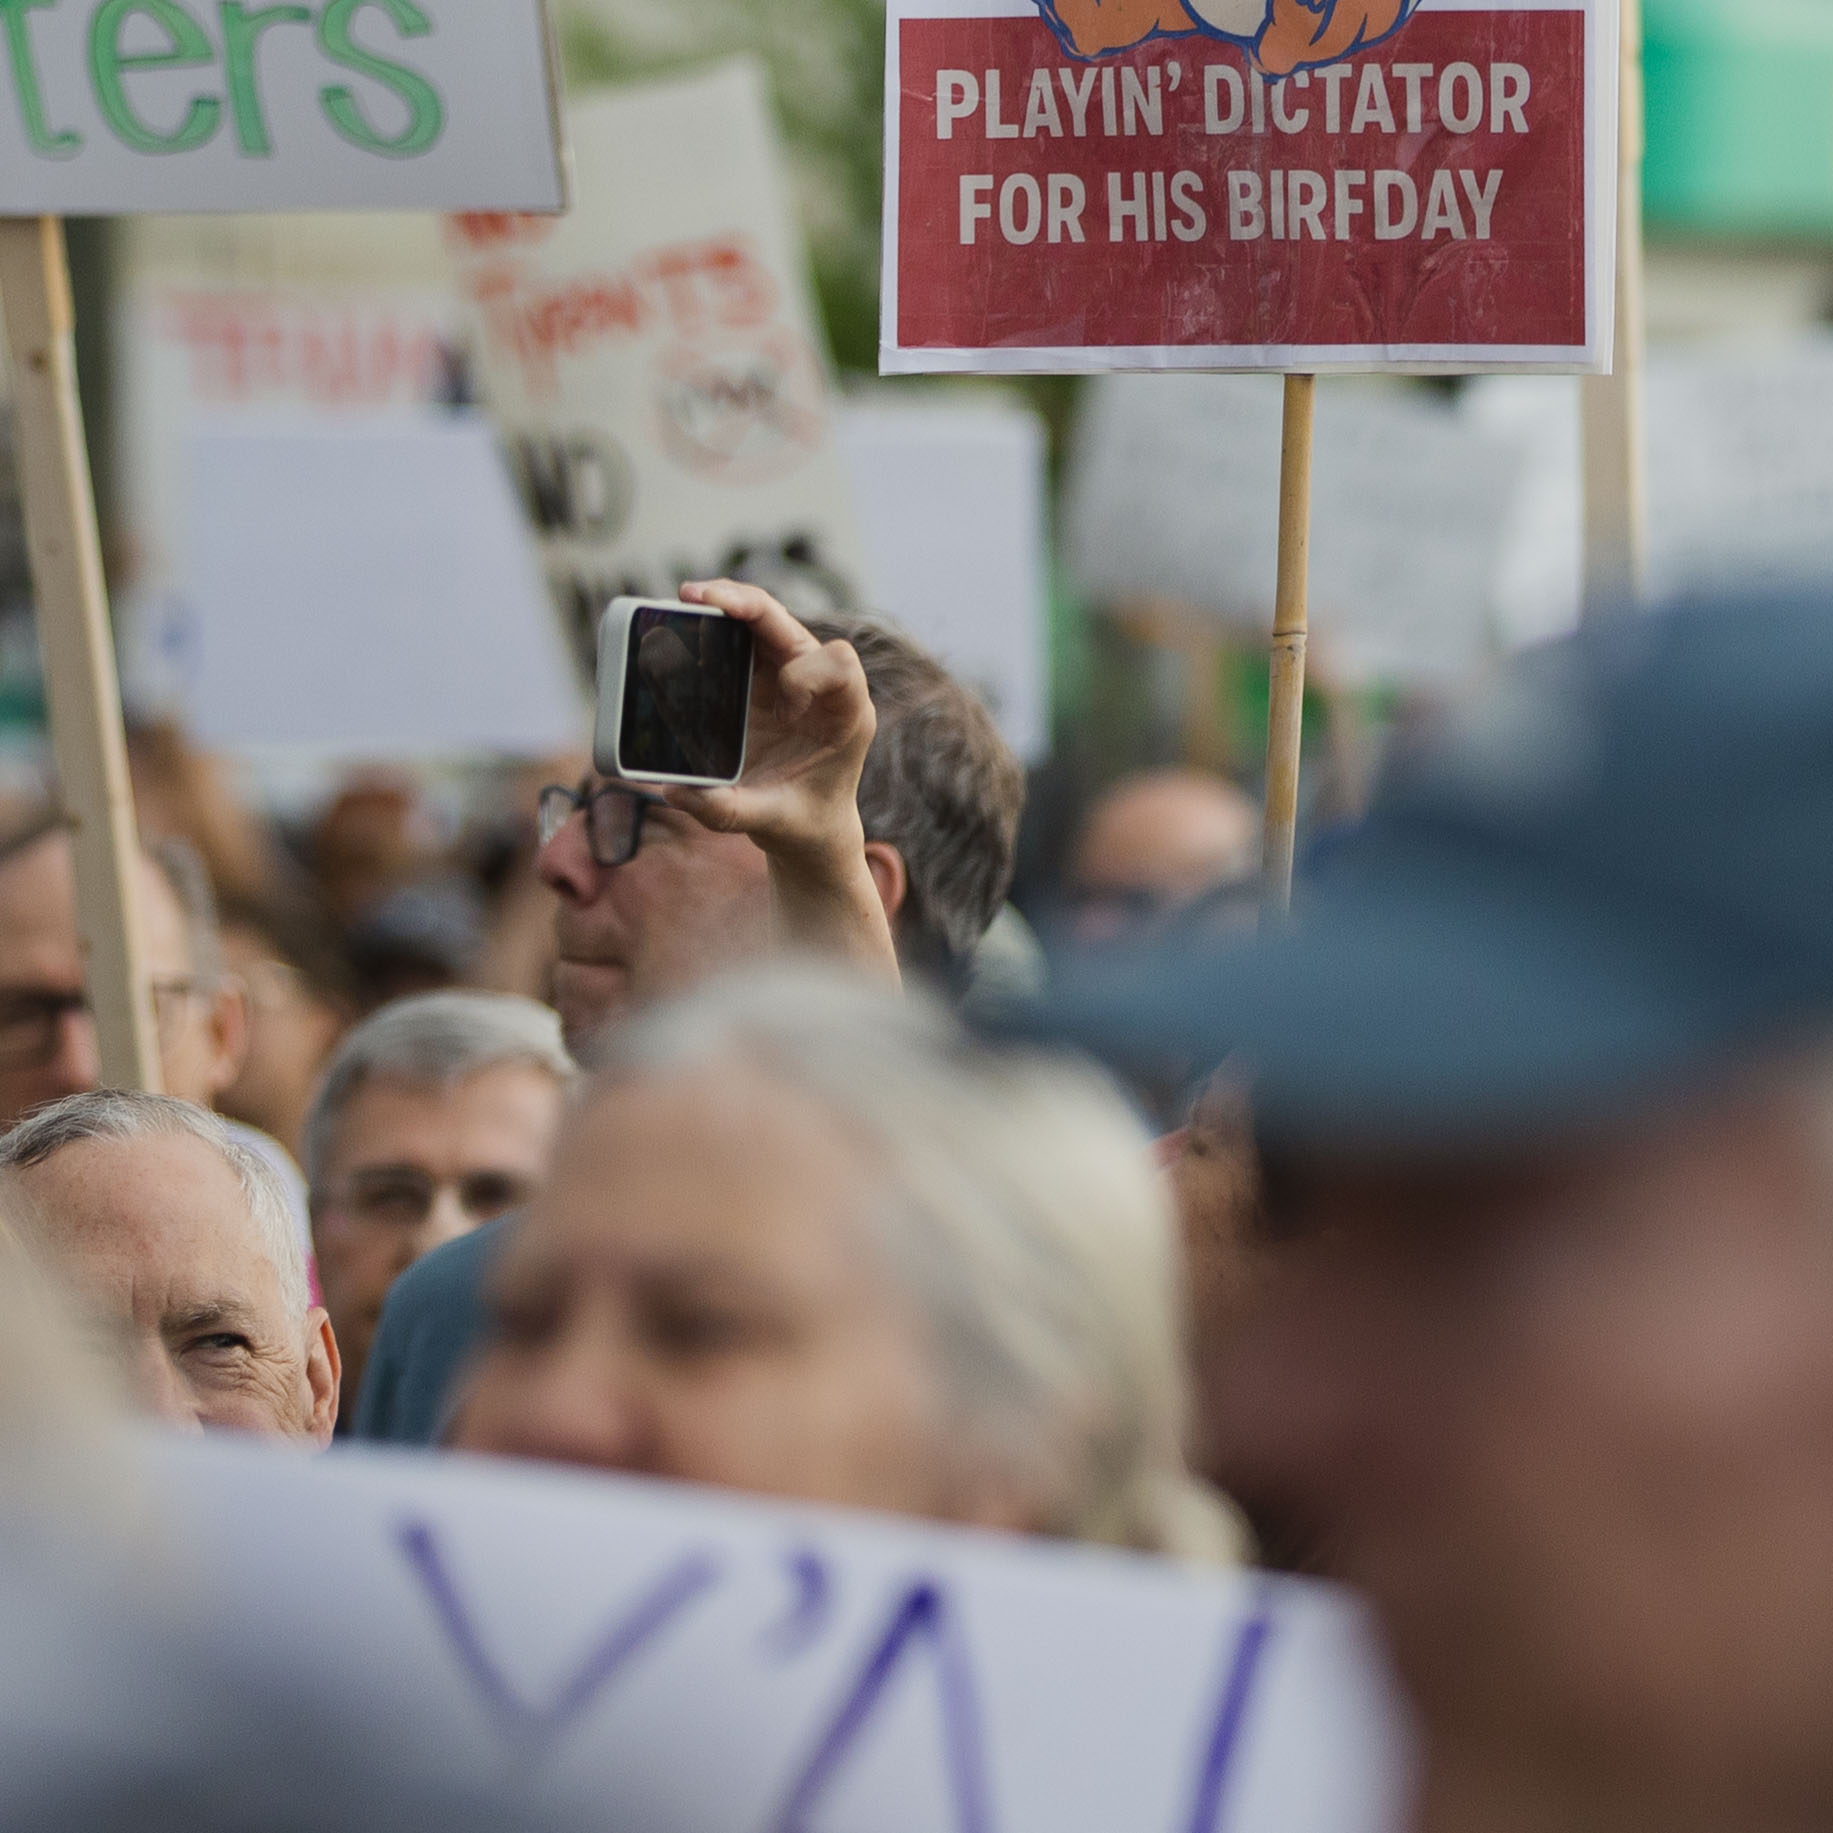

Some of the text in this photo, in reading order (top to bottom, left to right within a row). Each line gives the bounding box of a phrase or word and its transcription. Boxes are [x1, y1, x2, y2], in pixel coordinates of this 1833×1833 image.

[935, 60, 1531, 142] PLAYIN' DICTATOR
[957, 167, 1506, 247] FOR HIS BIRFDAY
